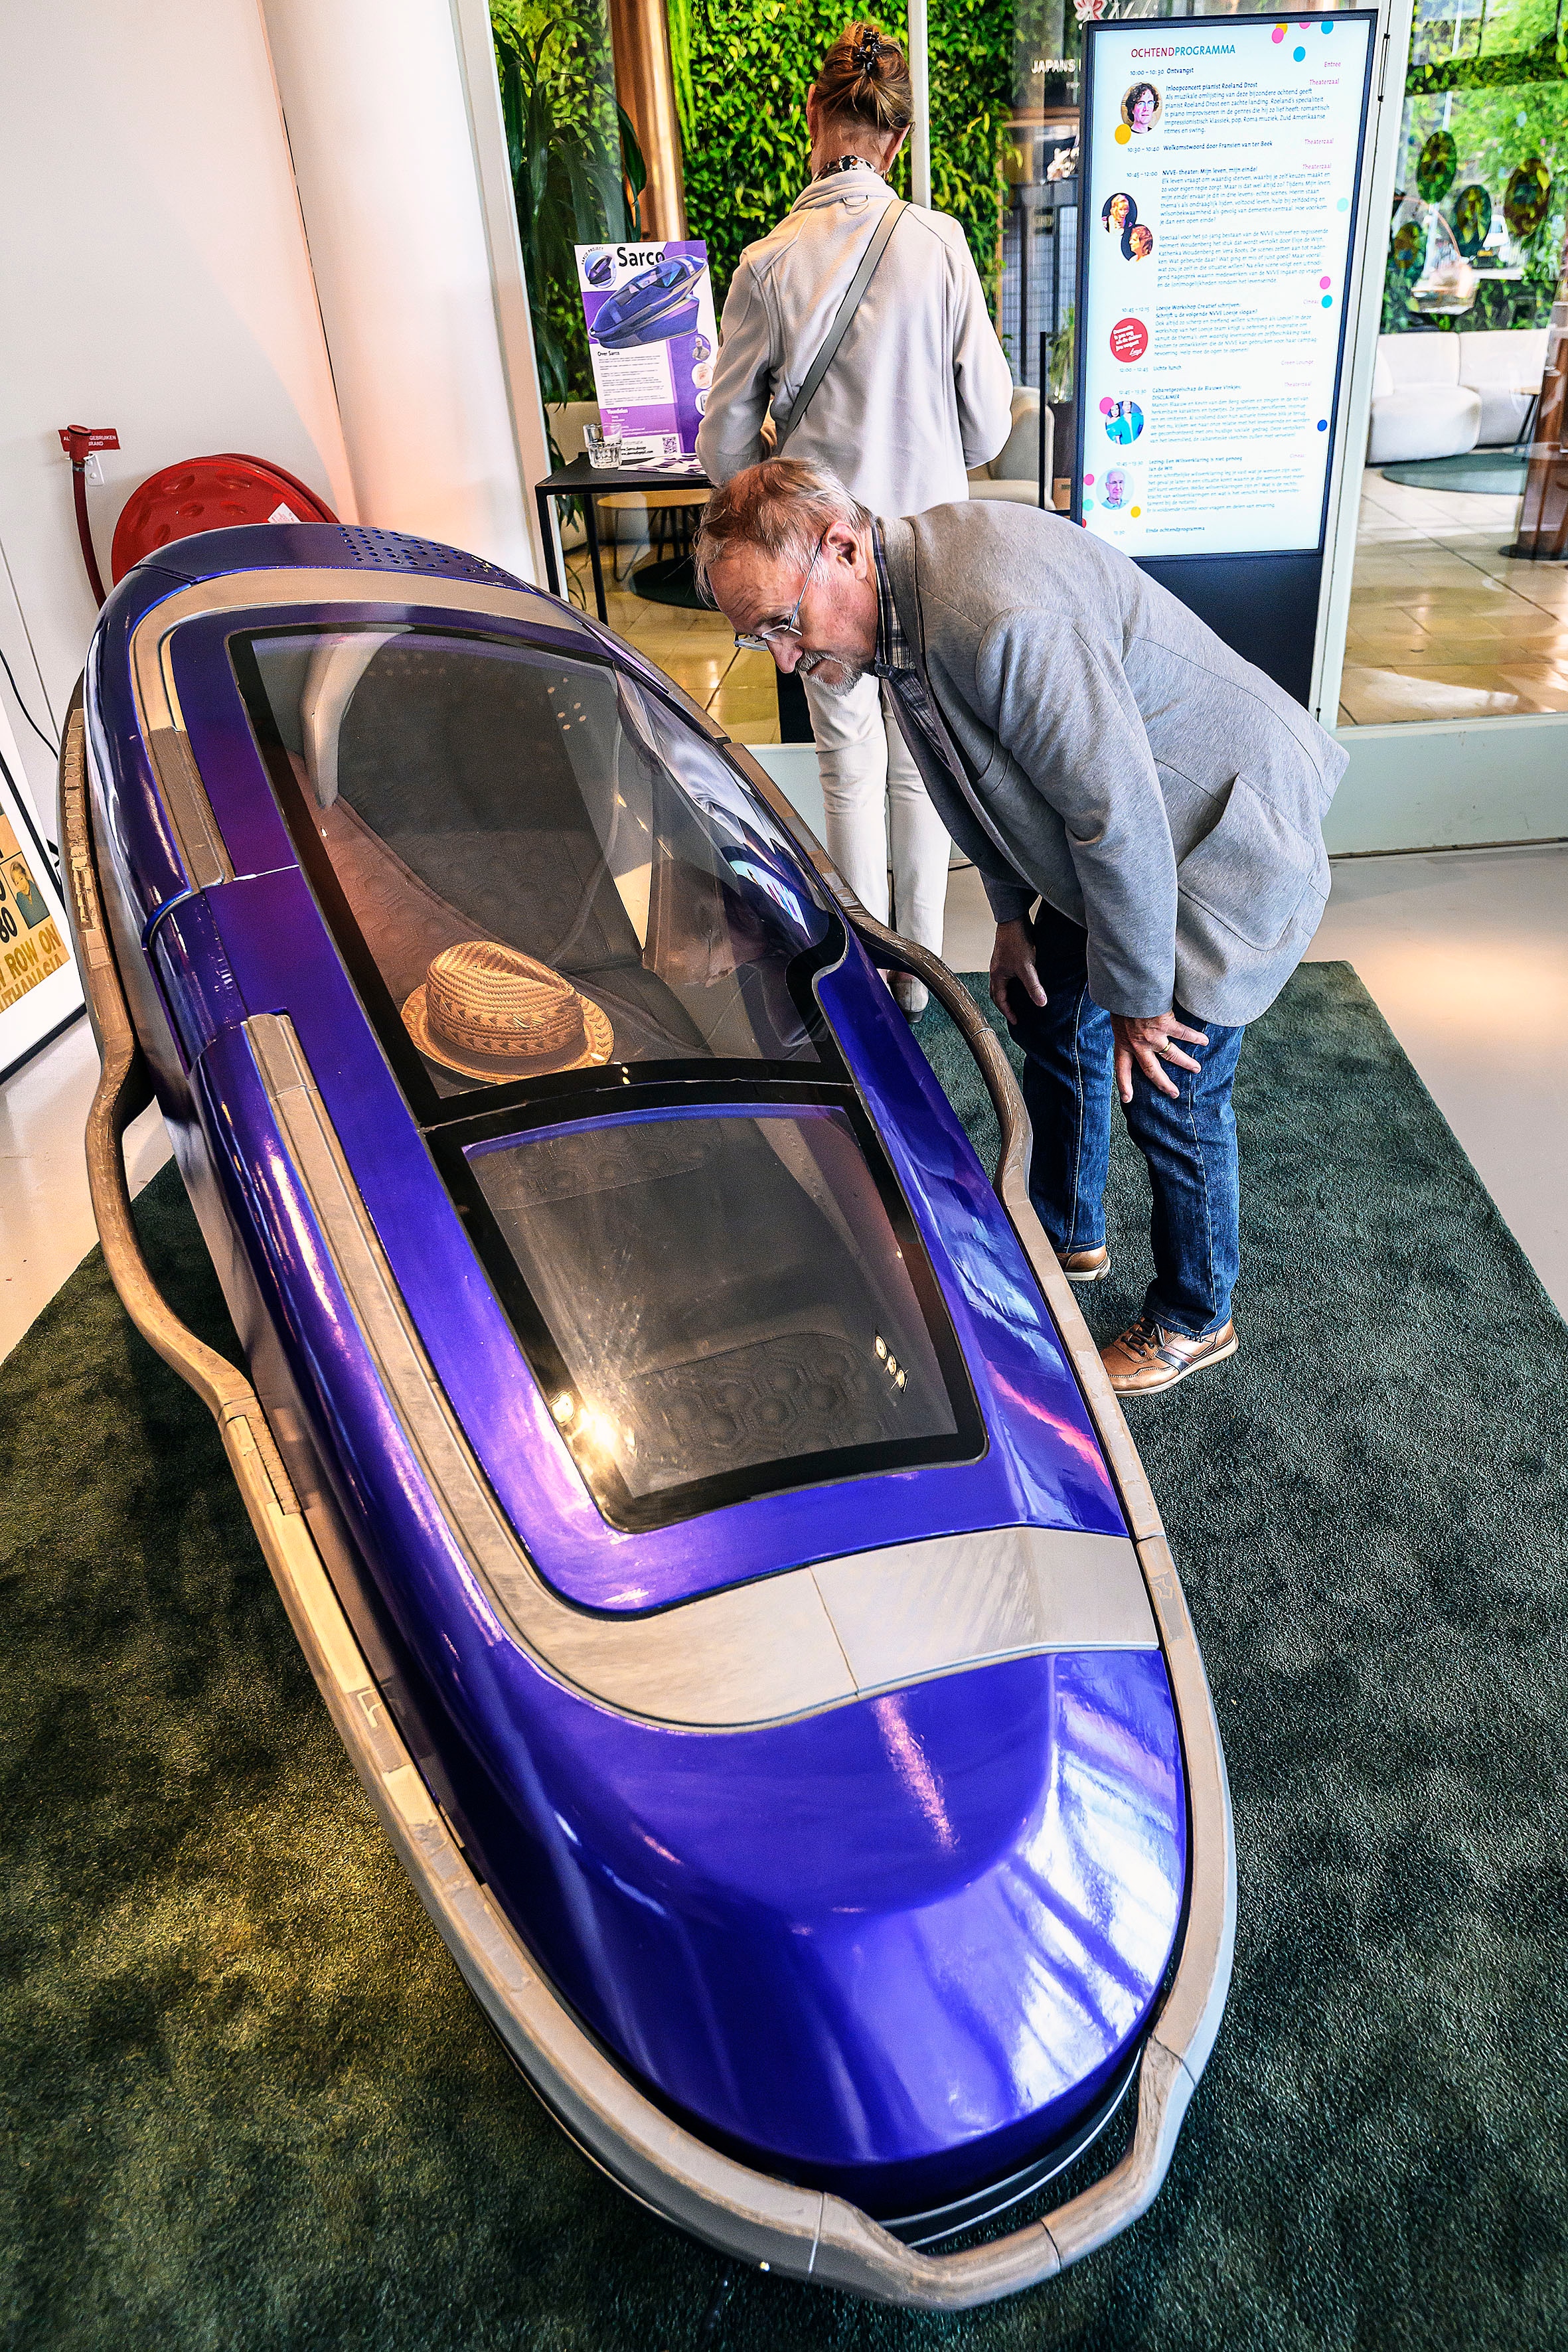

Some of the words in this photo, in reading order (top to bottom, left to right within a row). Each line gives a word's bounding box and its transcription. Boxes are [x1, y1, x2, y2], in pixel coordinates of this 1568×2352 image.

[1131, 44, 1236, 58] OCHTENDPROGRAMMA
[1031, 58, 1076, 74] JAPANS
[617, 247, 665, 267] Sarco
[5, 937, 39, 980] ROW
[39, 923, 61, 955] ON
